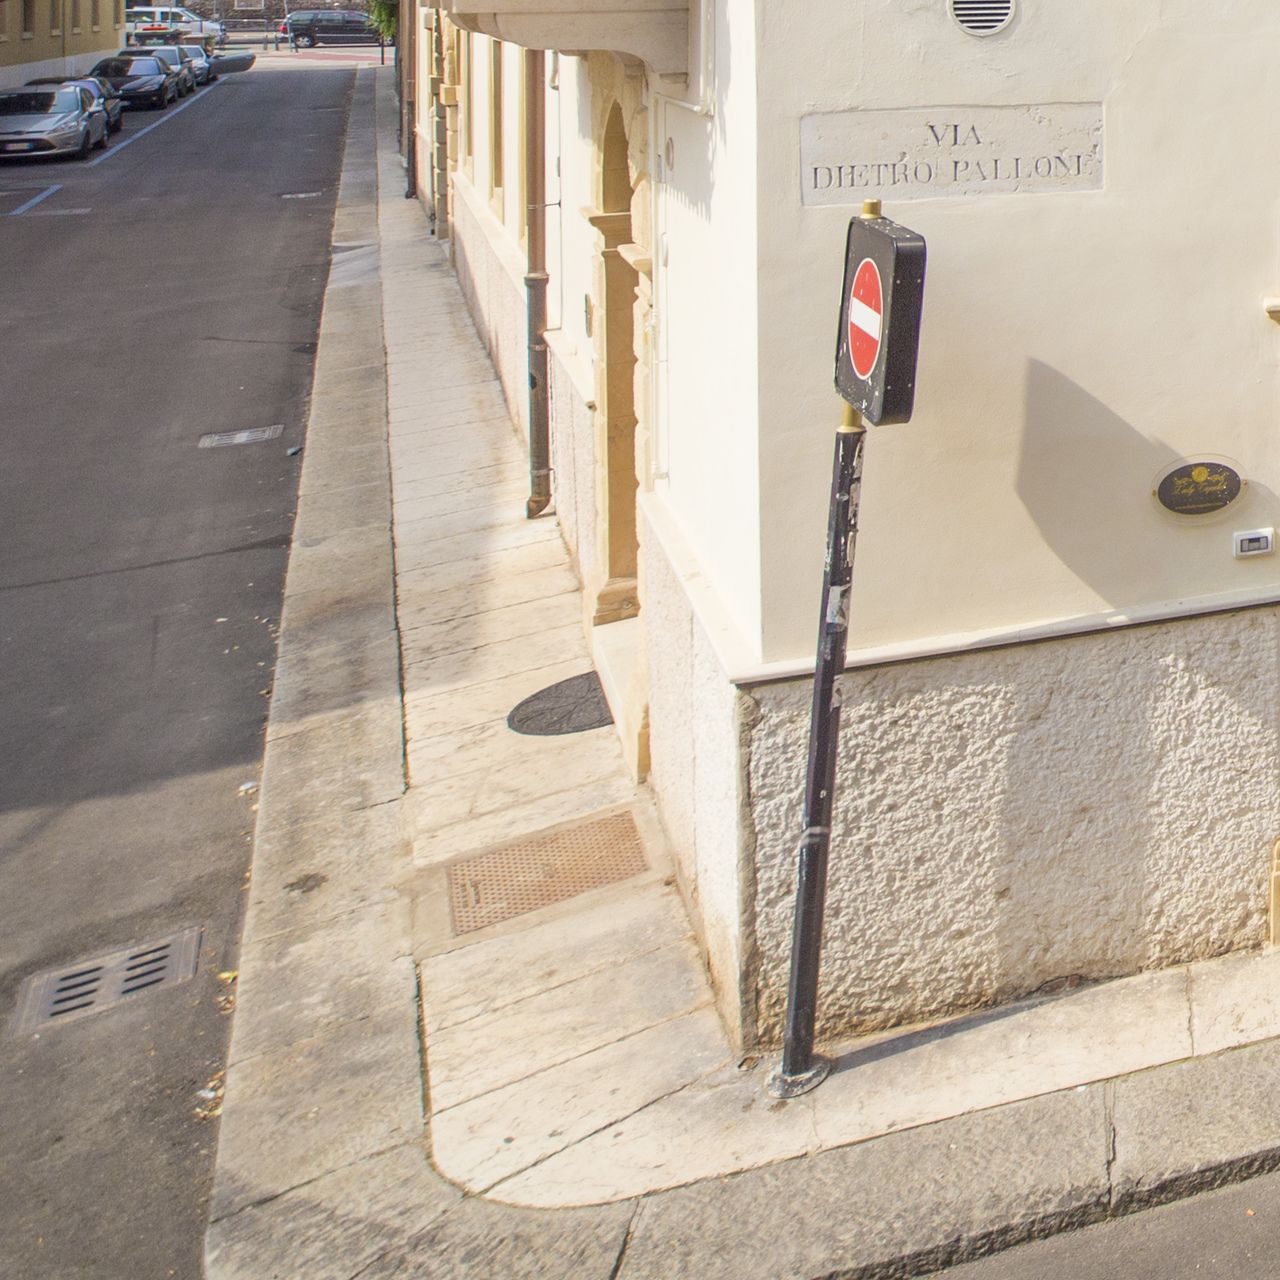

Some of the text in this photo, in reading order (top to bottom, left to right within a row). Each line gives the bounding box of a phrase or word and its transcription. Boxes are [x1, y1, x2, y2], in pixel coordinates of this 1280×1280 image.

[928, 123, 983, 147] VIA
[812, 154, 1092, 190] DIETRO PALLONE
